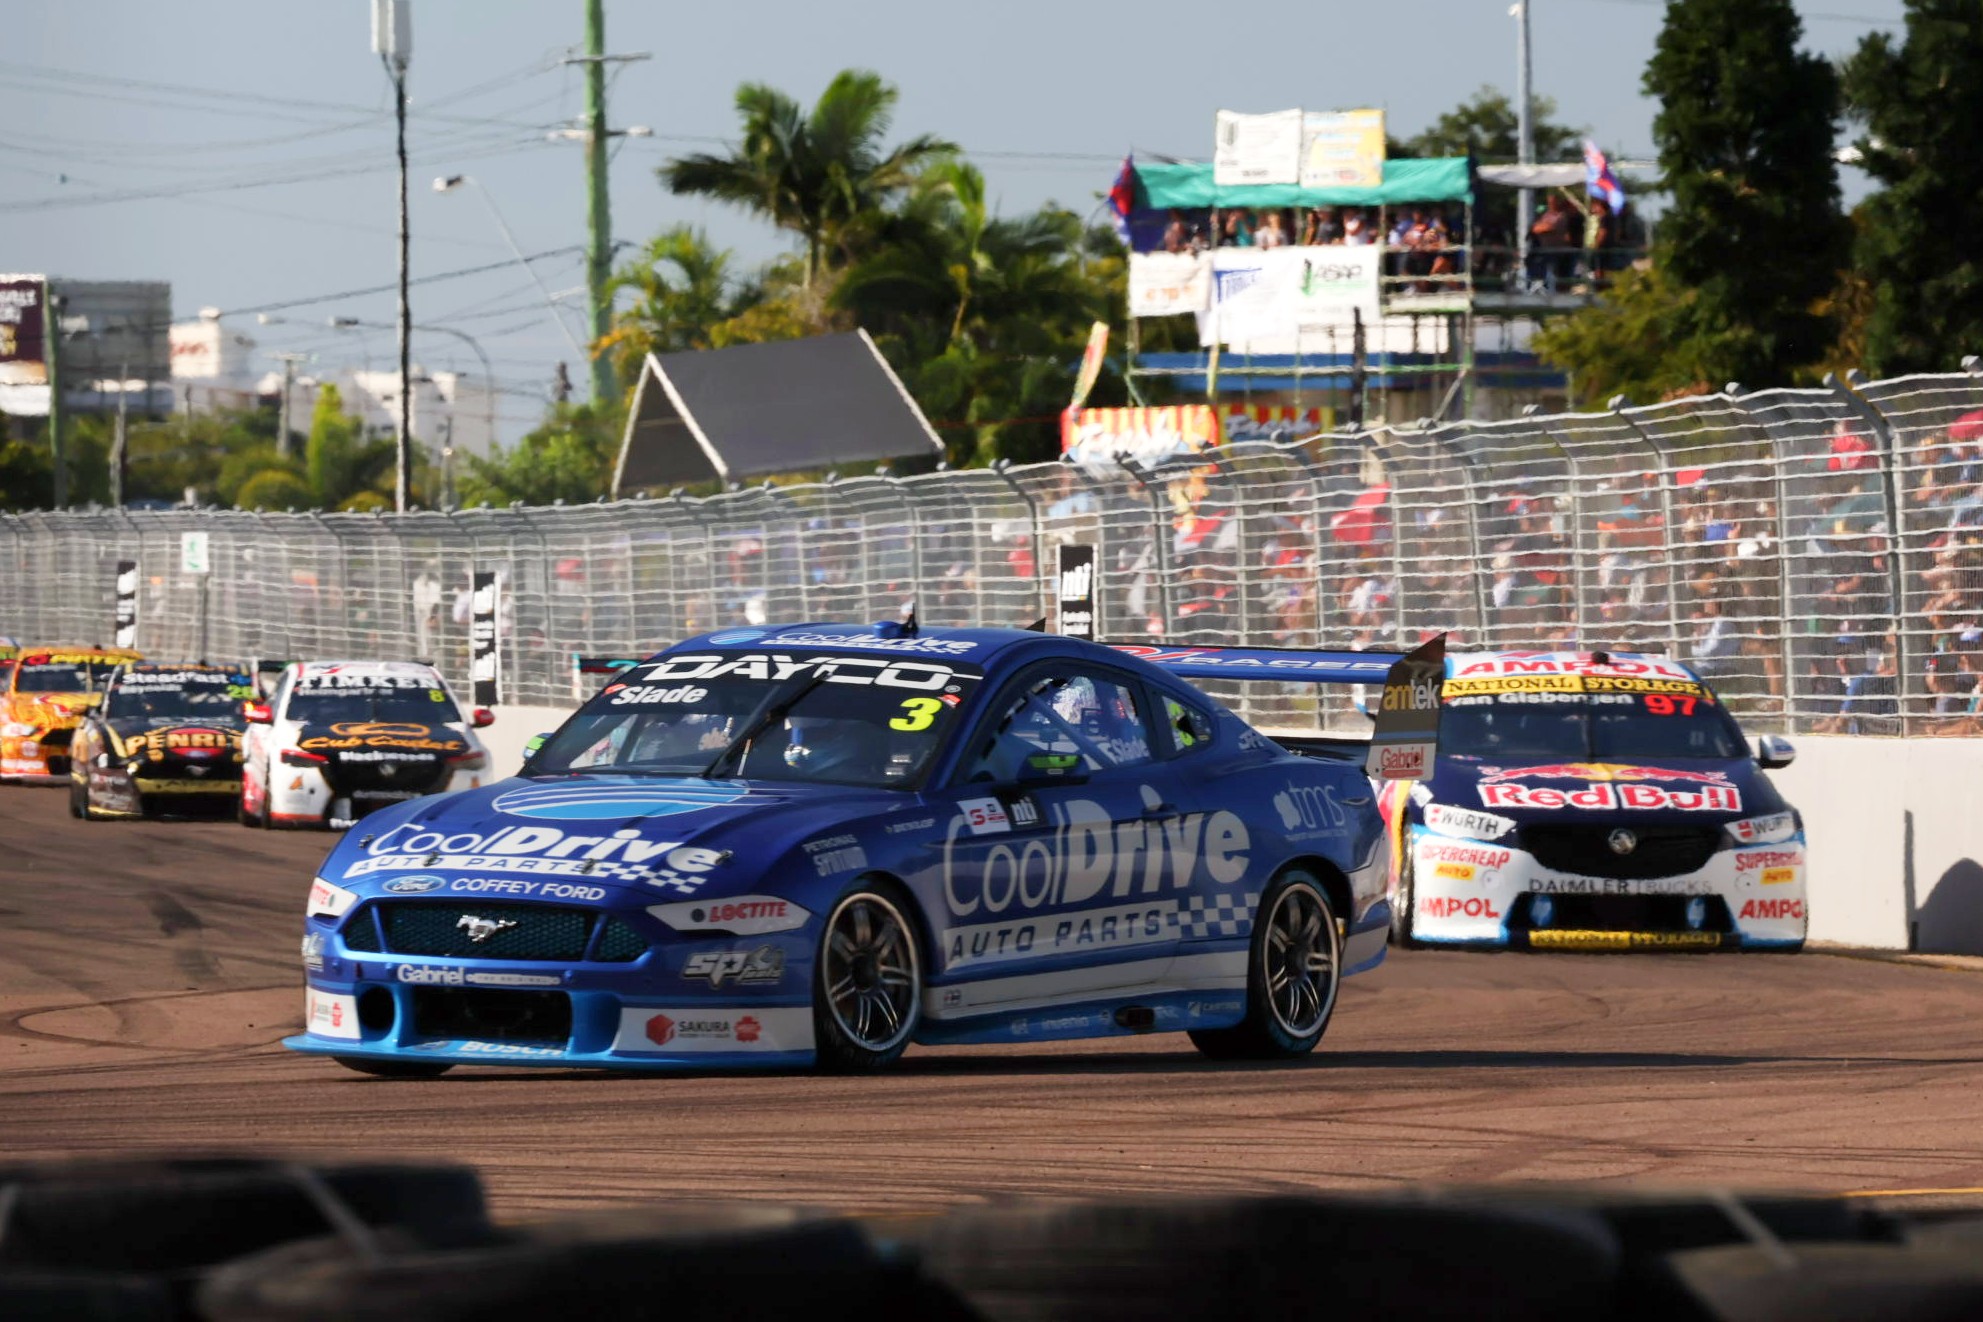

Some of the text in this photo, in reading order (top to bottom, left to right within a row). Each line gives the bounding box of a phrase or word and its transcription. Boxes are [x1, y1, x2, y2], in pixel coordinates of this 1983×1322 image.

[641, 655, 957, 690] DAYCO
[1457, 660, 1688, 679] AMPOL
[301, 676, 440, 689] TIMKEN
[1448, 676, 1702, 694] NATIONAL STORAGE
[429, 689, 446, 702] 8
[610, 685, 708, 704] Slade
[1383, 678, 1439, 710] amtek
[1448, 694, 1494, 707] van
[889, 697, 942, 731] 3
[1644, 694, 1698, 716] 97
[1381, 746, 1424, 770] Gabriel
[1478, 782, 1743, 812] Red Bull
[367, 823, 719, 873] CoolDrive
[944, 784, 1250, 917] CoolDrive
[451, 877, 606, 901] COFFEY FORD
[1528, 877, 1629, 894] DAIMLER
[709, 902, 788, 922] LOCTITE
[951, 909, 1161, 961] AUTO PARTS
[397, 964, 465, 985] Gabriel
[678, 1021, 731, 1034] SAKURA
